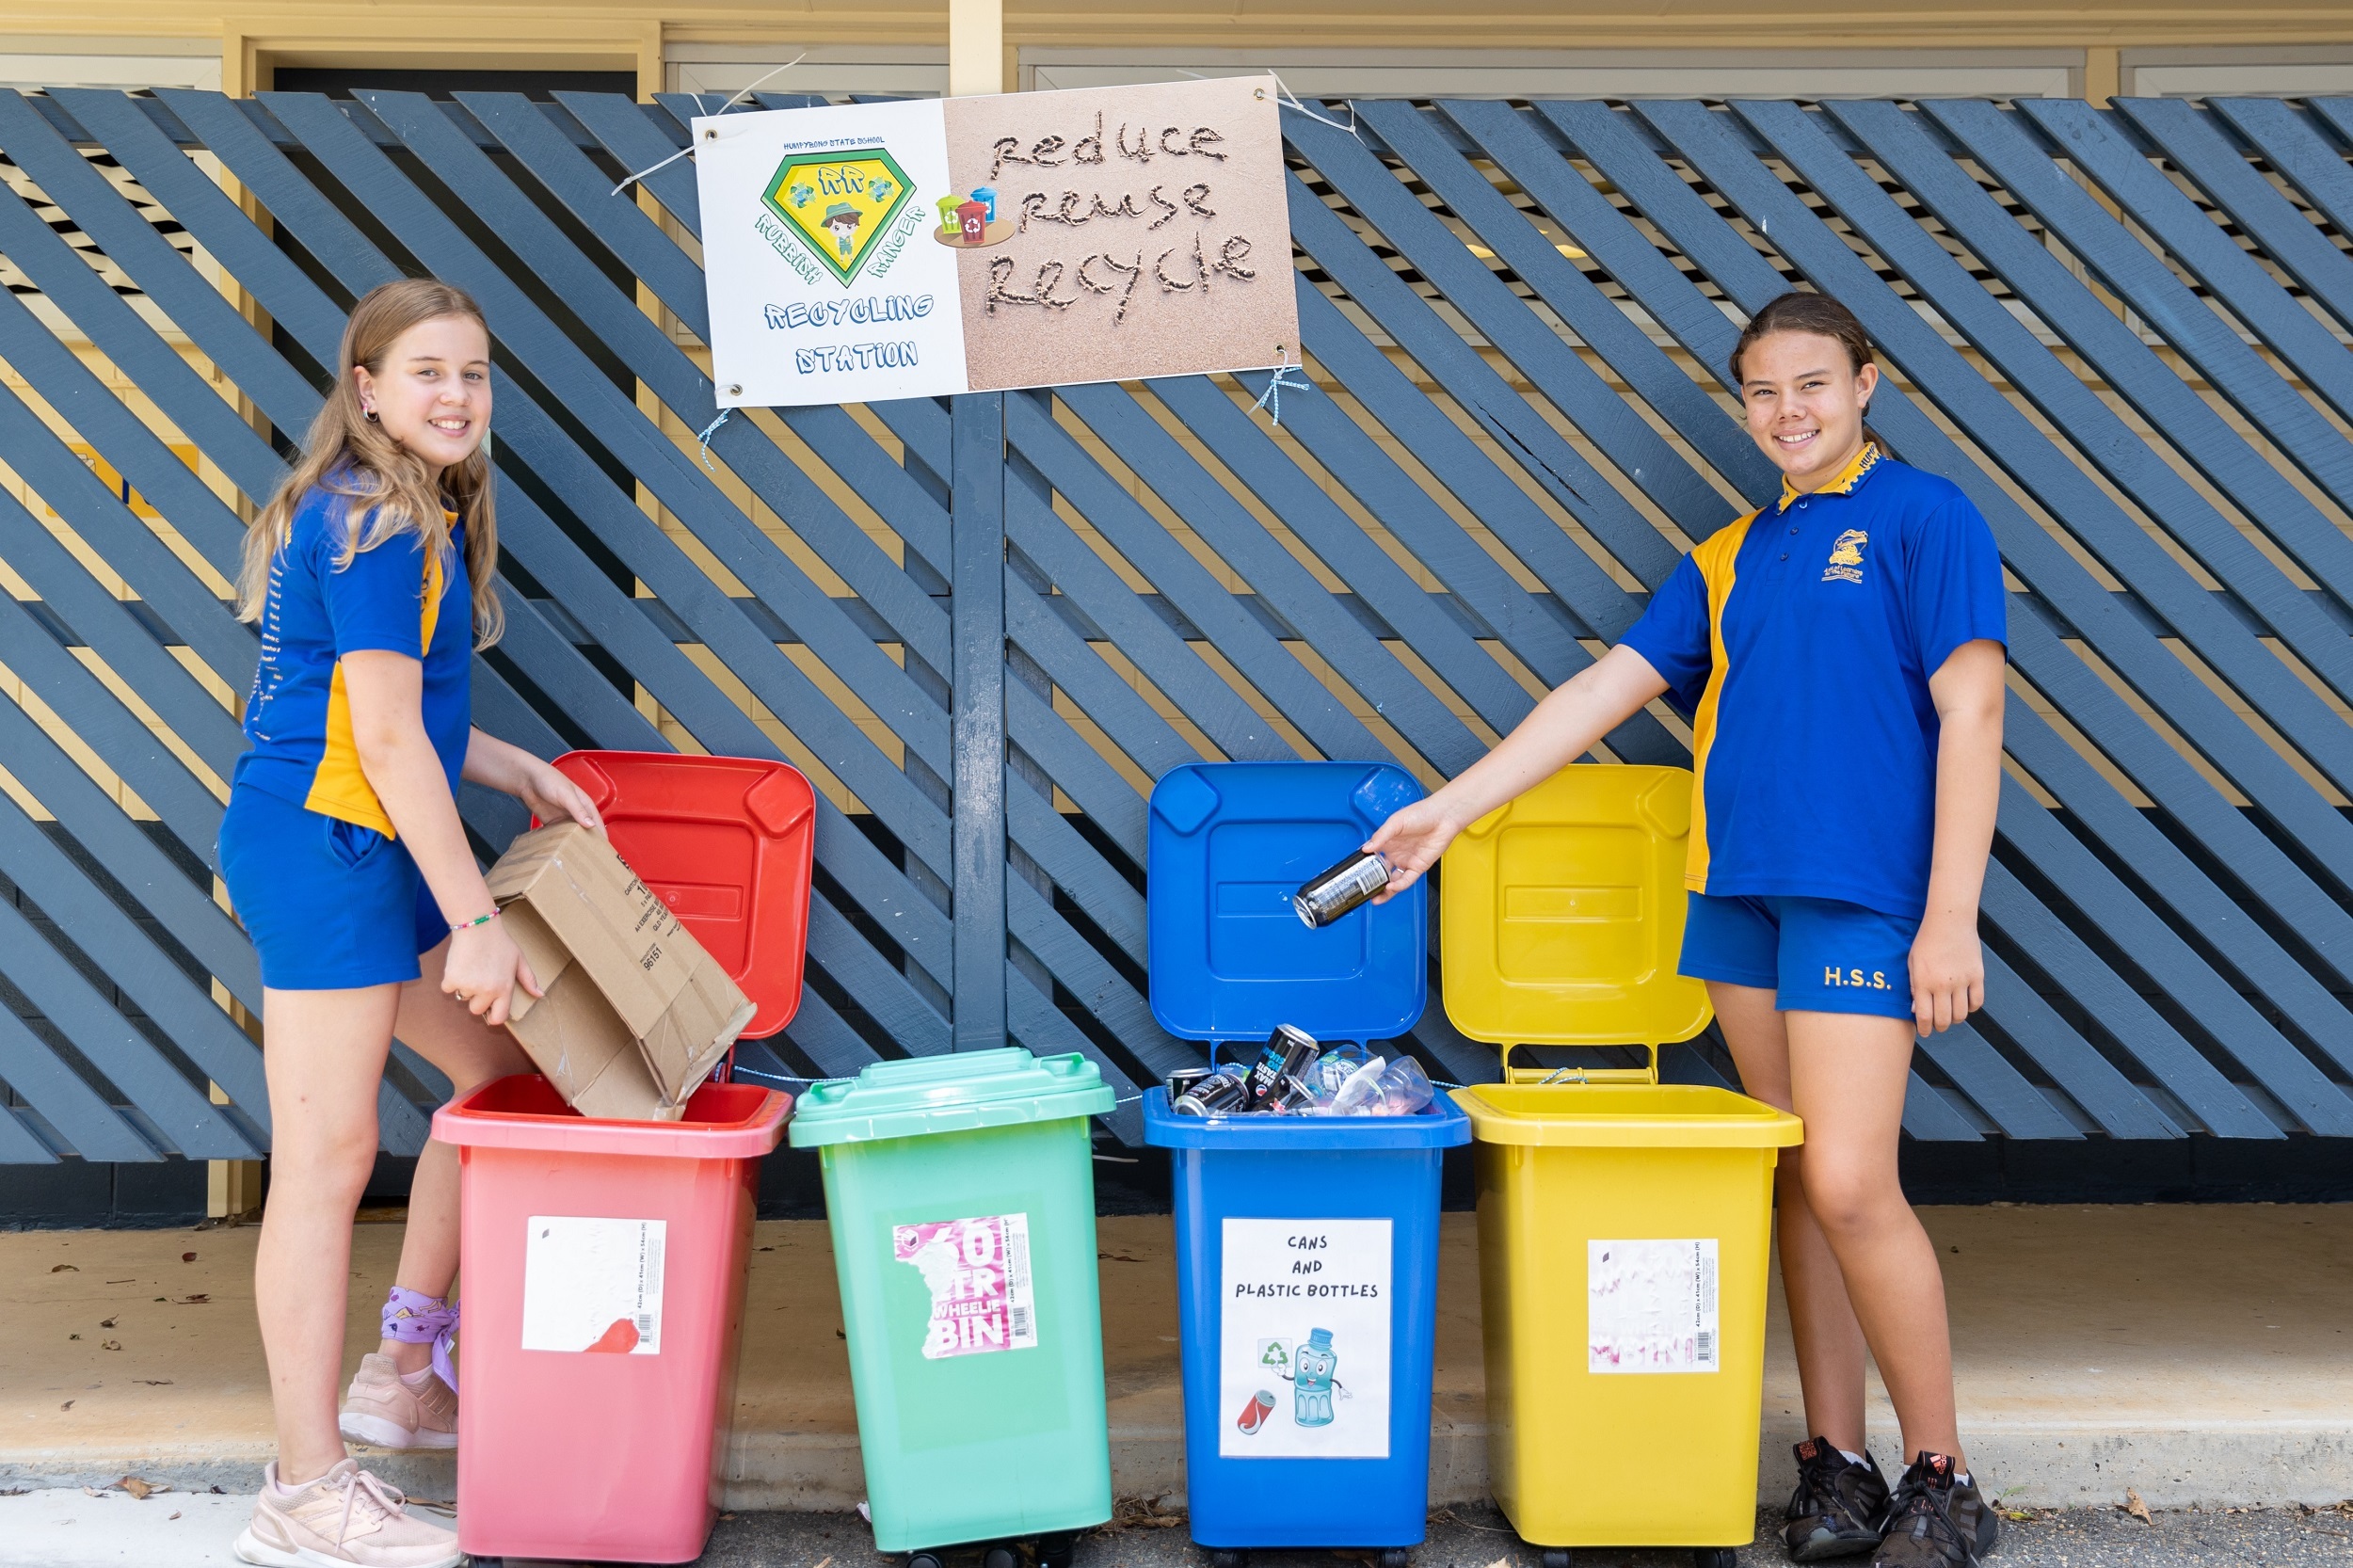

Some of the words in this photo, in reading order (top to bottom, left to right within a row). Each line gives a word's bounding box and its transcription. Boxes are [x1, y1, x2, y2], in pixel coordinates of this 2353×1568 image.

[783, 140, 828, 150] HUMPYBONG
[829, 137, 856, 147] STATE
[857, 136, 885, 145] SCHOOL
[818, 165, 865, 196] RR
[755, 213, 824, 285] RUBBISH
[867, 205, 926, 279] RANGER
[764, 295, 934, 329] RECYCLING
[796, 341, 919, 375] STATION
[624, 878, 639, 896] CARTON
[639, 904, 656, 929] EXERCISE
[652, 920, 662, 932] QLD
[643, 946, 663, 971] 96151
[1824, 967, 1892, 990] H.S.S.
[1257, 1062, 1276, 1080] TASTE
[1267, 1056, 1282, 1072] NO
[1254, 1070, 1273, 1087] MAX
[1288, 1236, 1328, 1250] CANS
[1292, 1260, 1322, 1274] AND
[1236, 1284, 1302, 1298] PLASTIC
[1307, 1284, 1378, 1298] BOTTLES
[933, 1299, 1001, 1320] WHEELIE
[936, 1314, 1004, 1352] BIN
